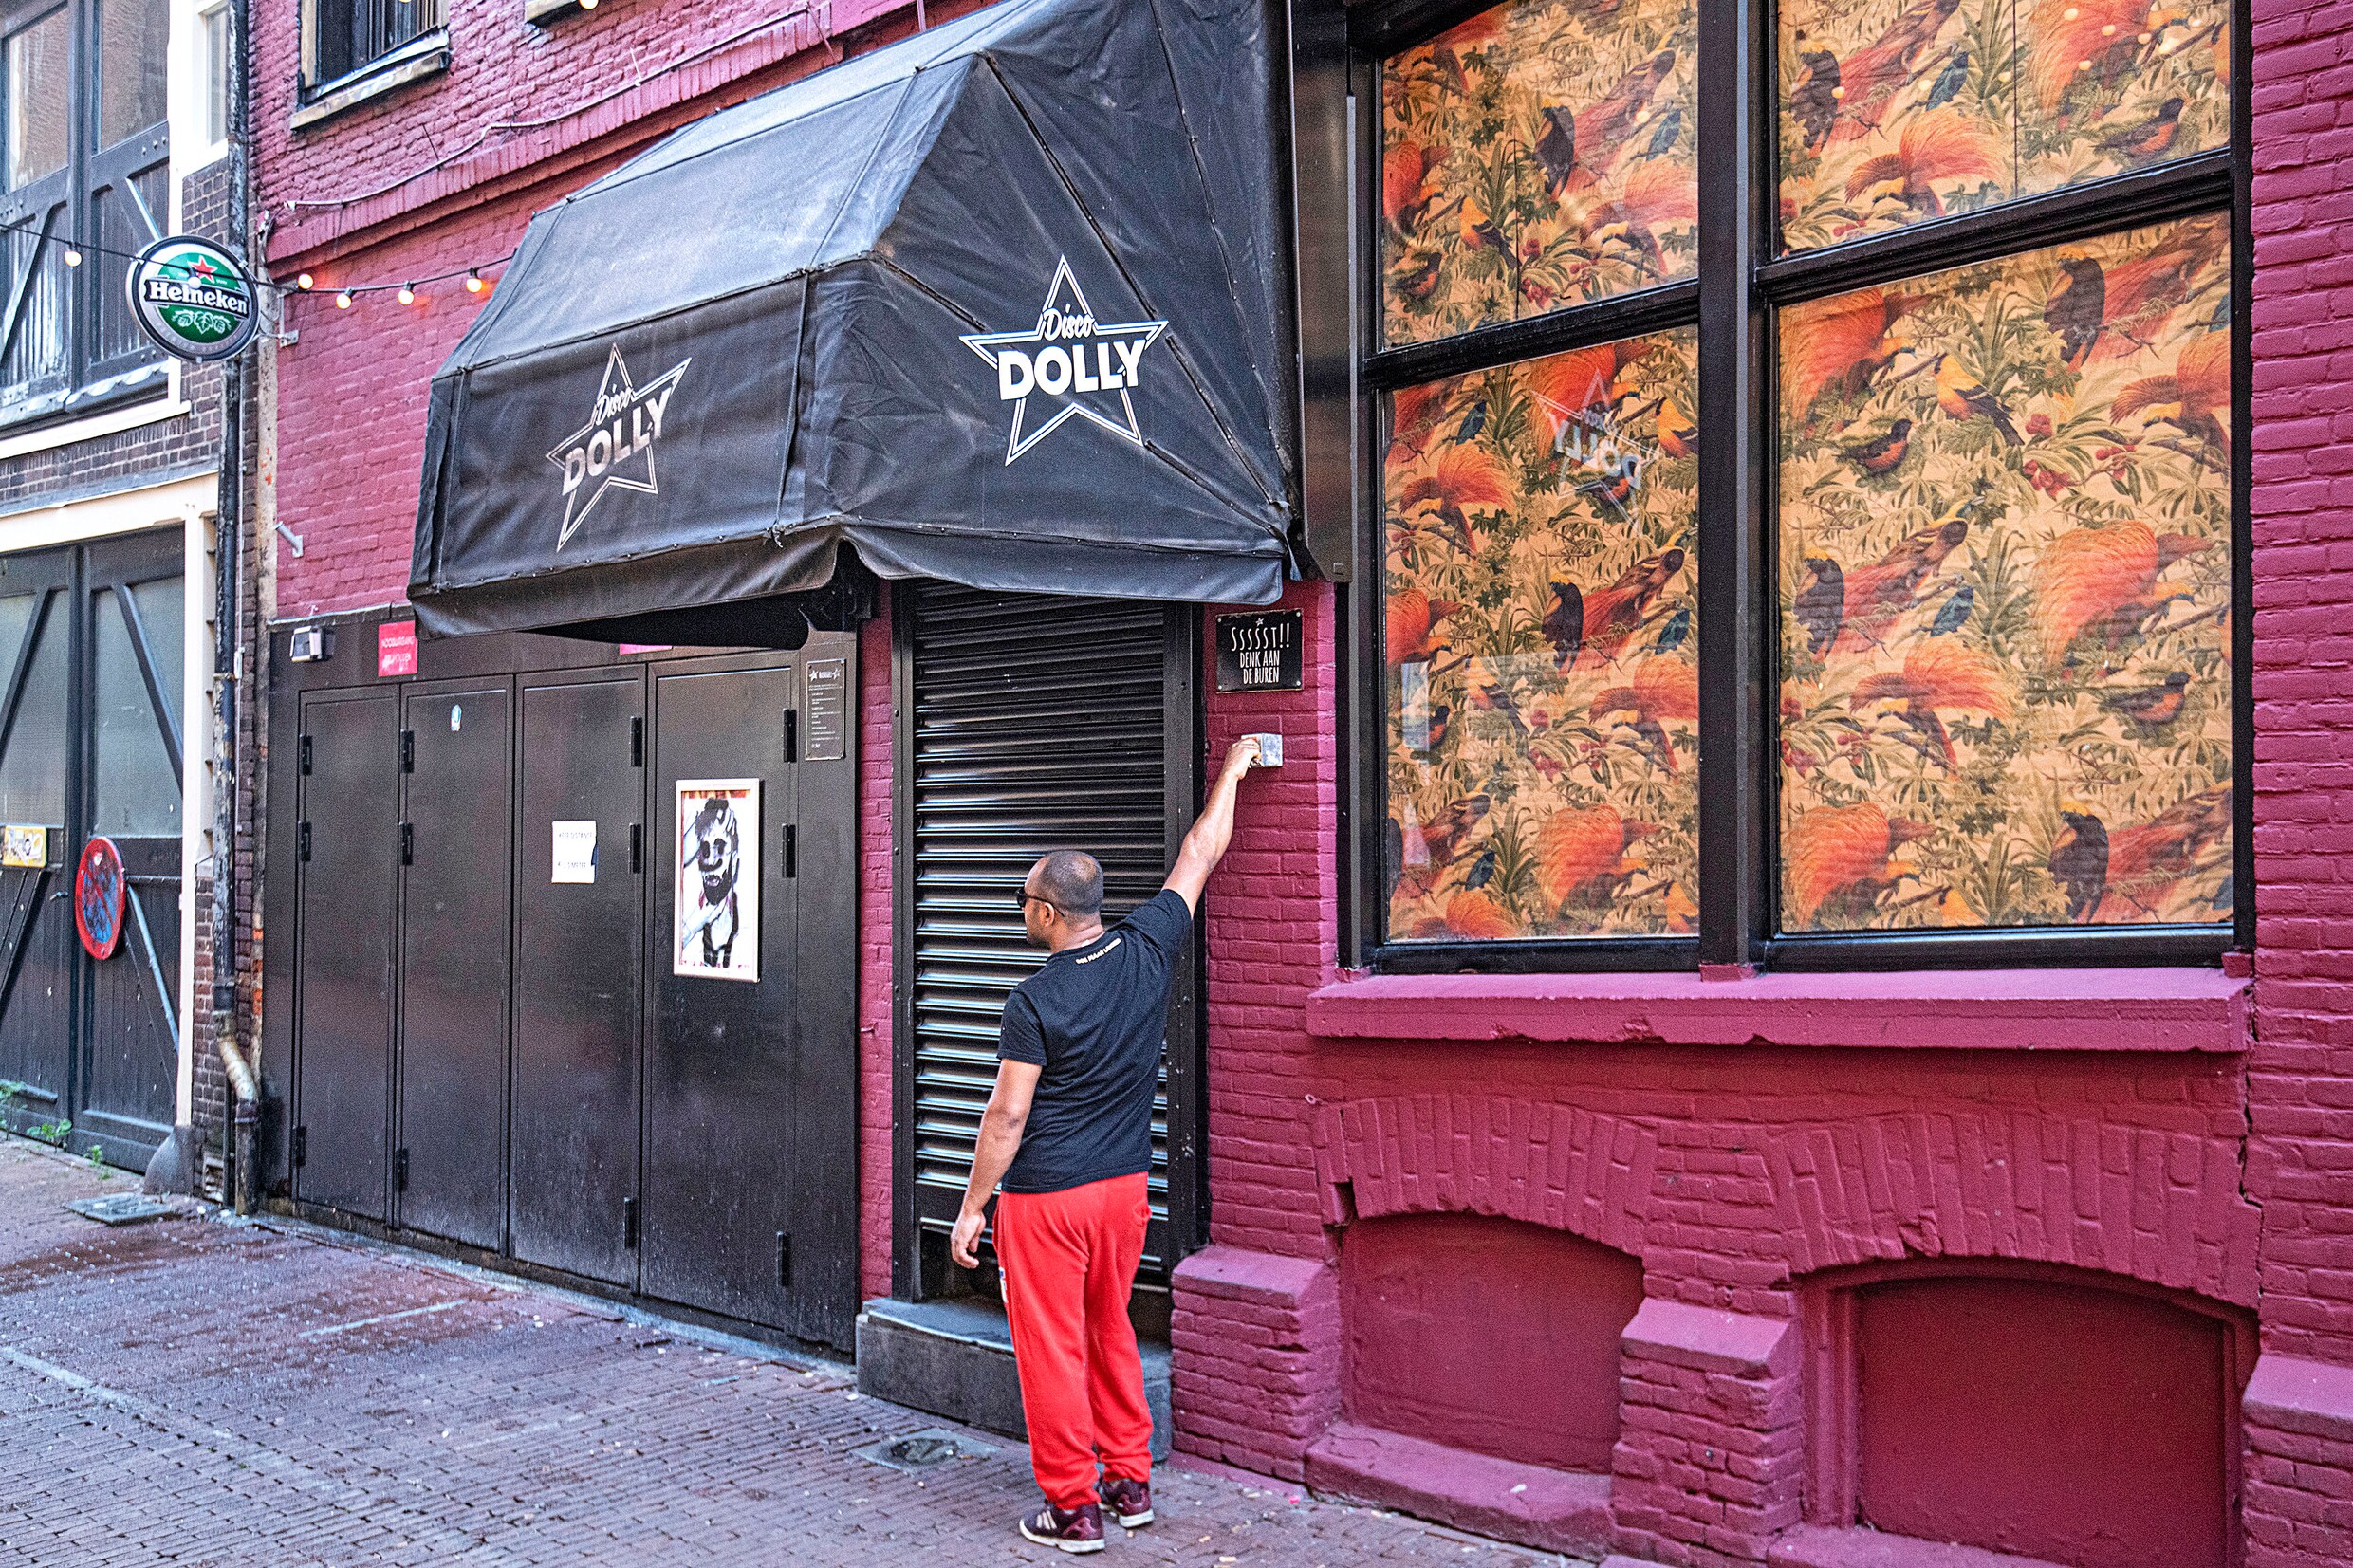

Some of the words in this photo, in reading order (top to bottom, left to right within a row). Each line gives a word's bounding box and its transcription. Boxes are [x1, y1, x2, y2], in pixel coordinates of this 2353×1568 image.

[149, 281, 249, 315] Heineken
[1043, 303, 1095, 341] Disco
[998, 339, 1146, 400] DOLLY
[595, 383, 633, 426] Disco
[562, 387, 672, 496] DOLLY
[1239, 651, 1261, 668] DENK
[1263, 650, 1280, 667] AAN
[1243, 668, 1253, 684] DE
[1254, 667, 1280, 684] BUREN
